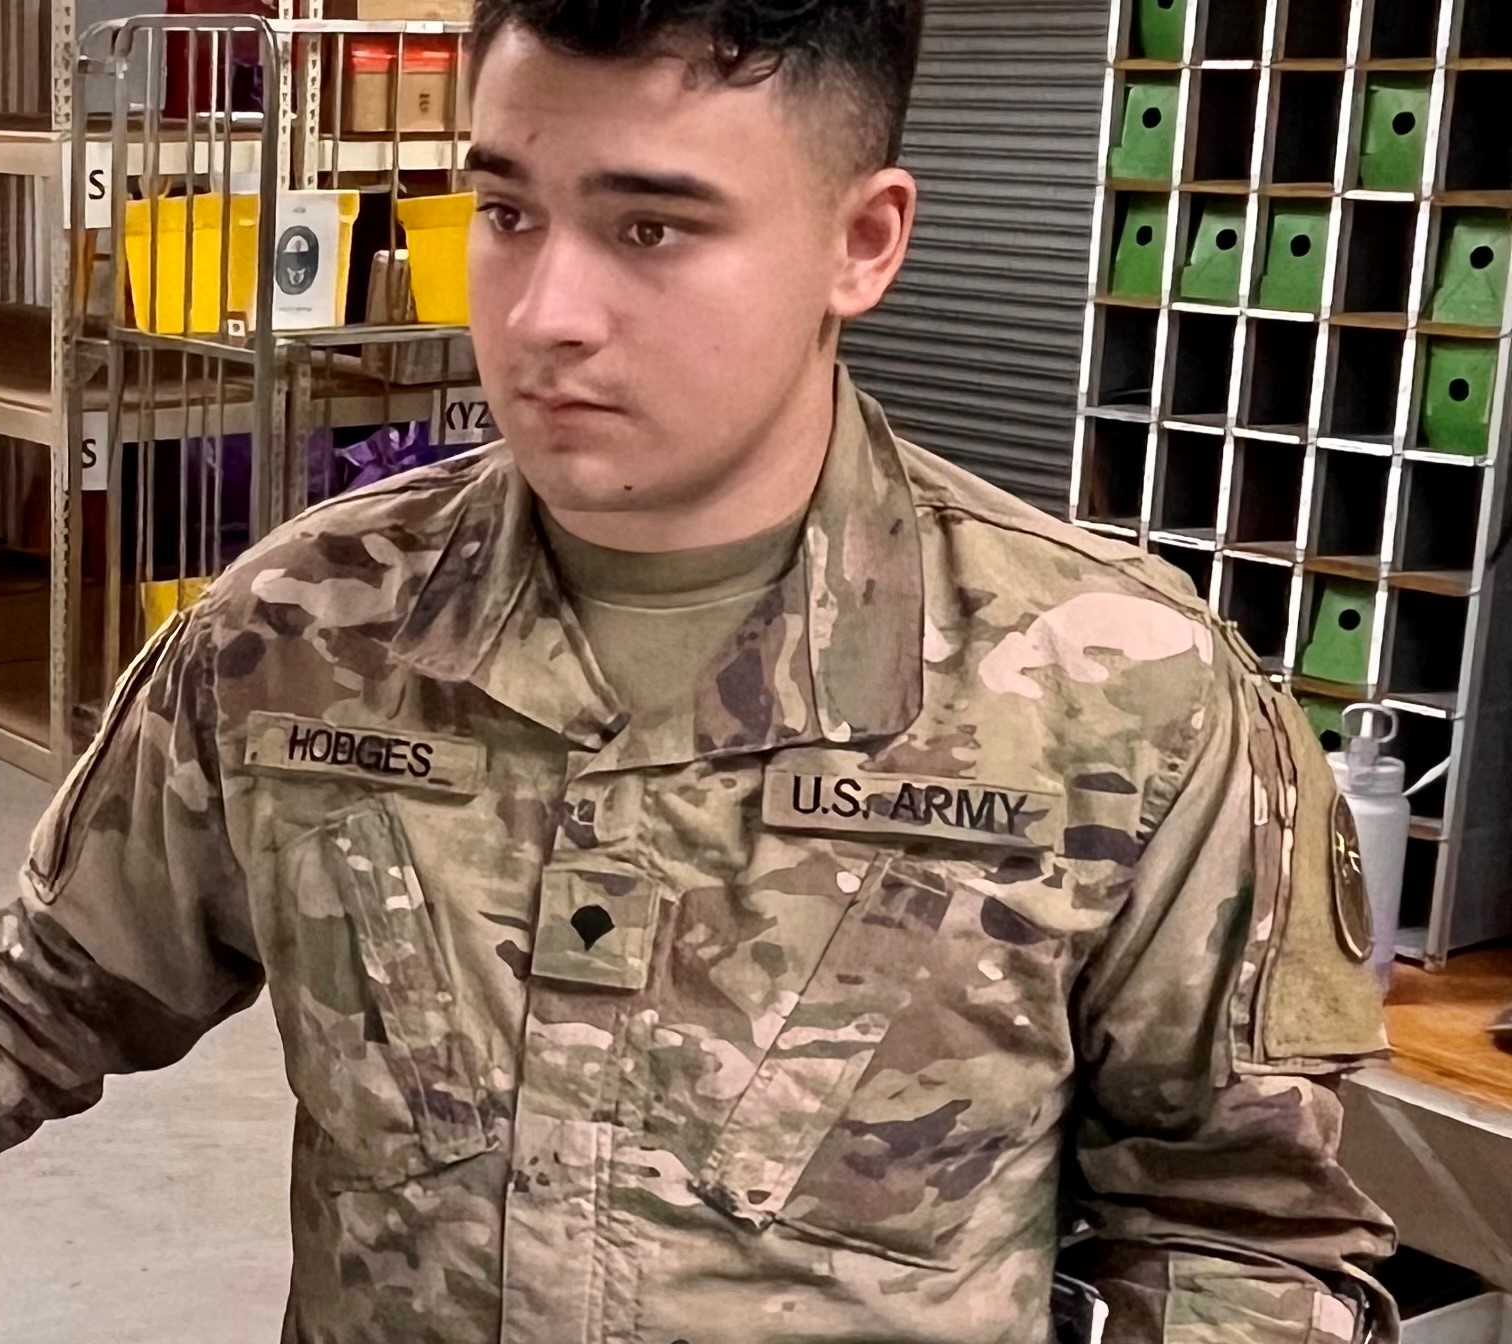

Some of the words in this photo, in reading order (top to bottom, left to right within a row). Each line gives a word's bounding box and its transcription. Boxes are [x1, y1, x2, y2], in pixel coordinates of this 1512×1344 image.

[88, 169, 106, 200] S
[82, 438, 97, 469] S
[288, 724, 434, 778] HODGES
[792, 775, 870, 820] U.S.
[890, 782, 1028, 835] ARMY
